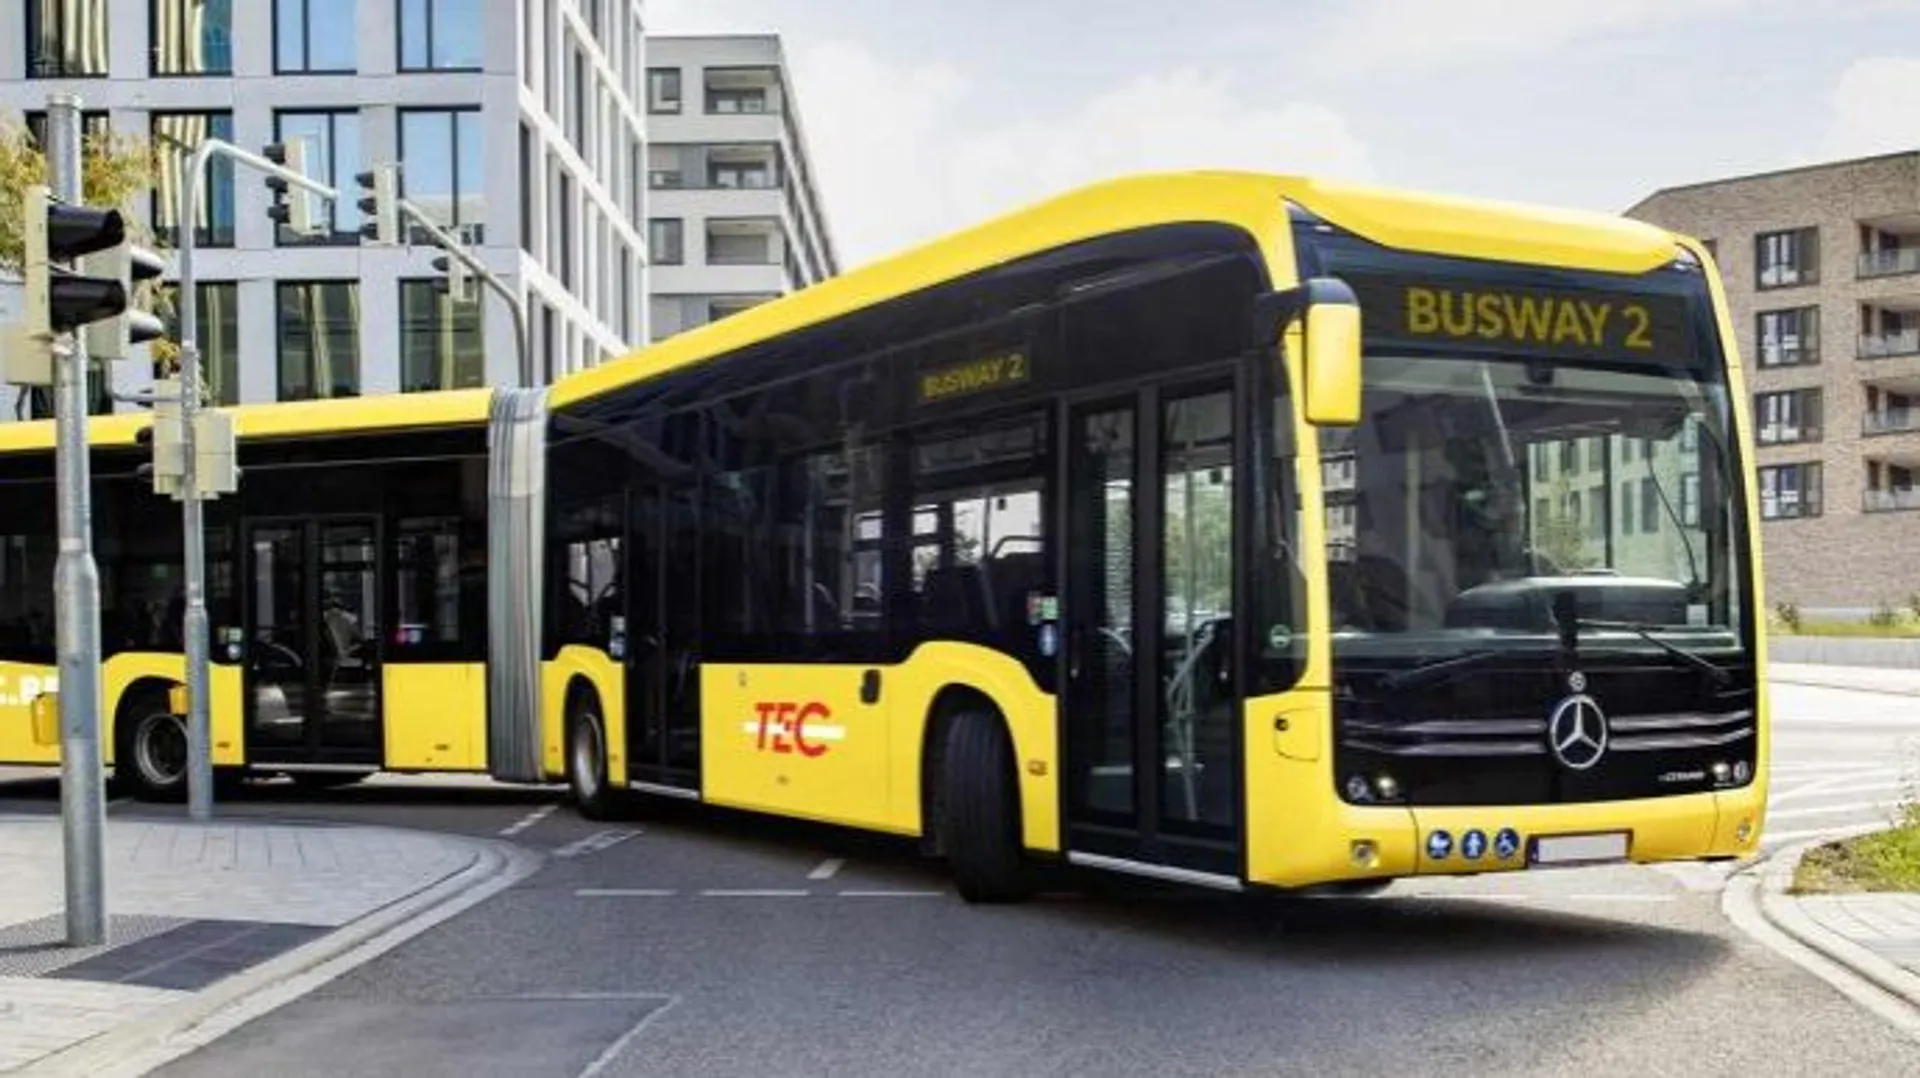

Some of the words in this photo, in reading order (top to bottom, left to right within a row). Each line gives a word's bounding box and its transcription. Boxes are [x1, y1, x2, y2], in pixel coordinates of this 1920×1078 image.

[1406, 287, 1611, 346] BUSWAY
[1624, 305, 1652, 348] 2
[922, 357, 1002, 398] BUSWAY
[1008, 352, 1024, 379] 2
[756, 702, 831, 757] TEC
